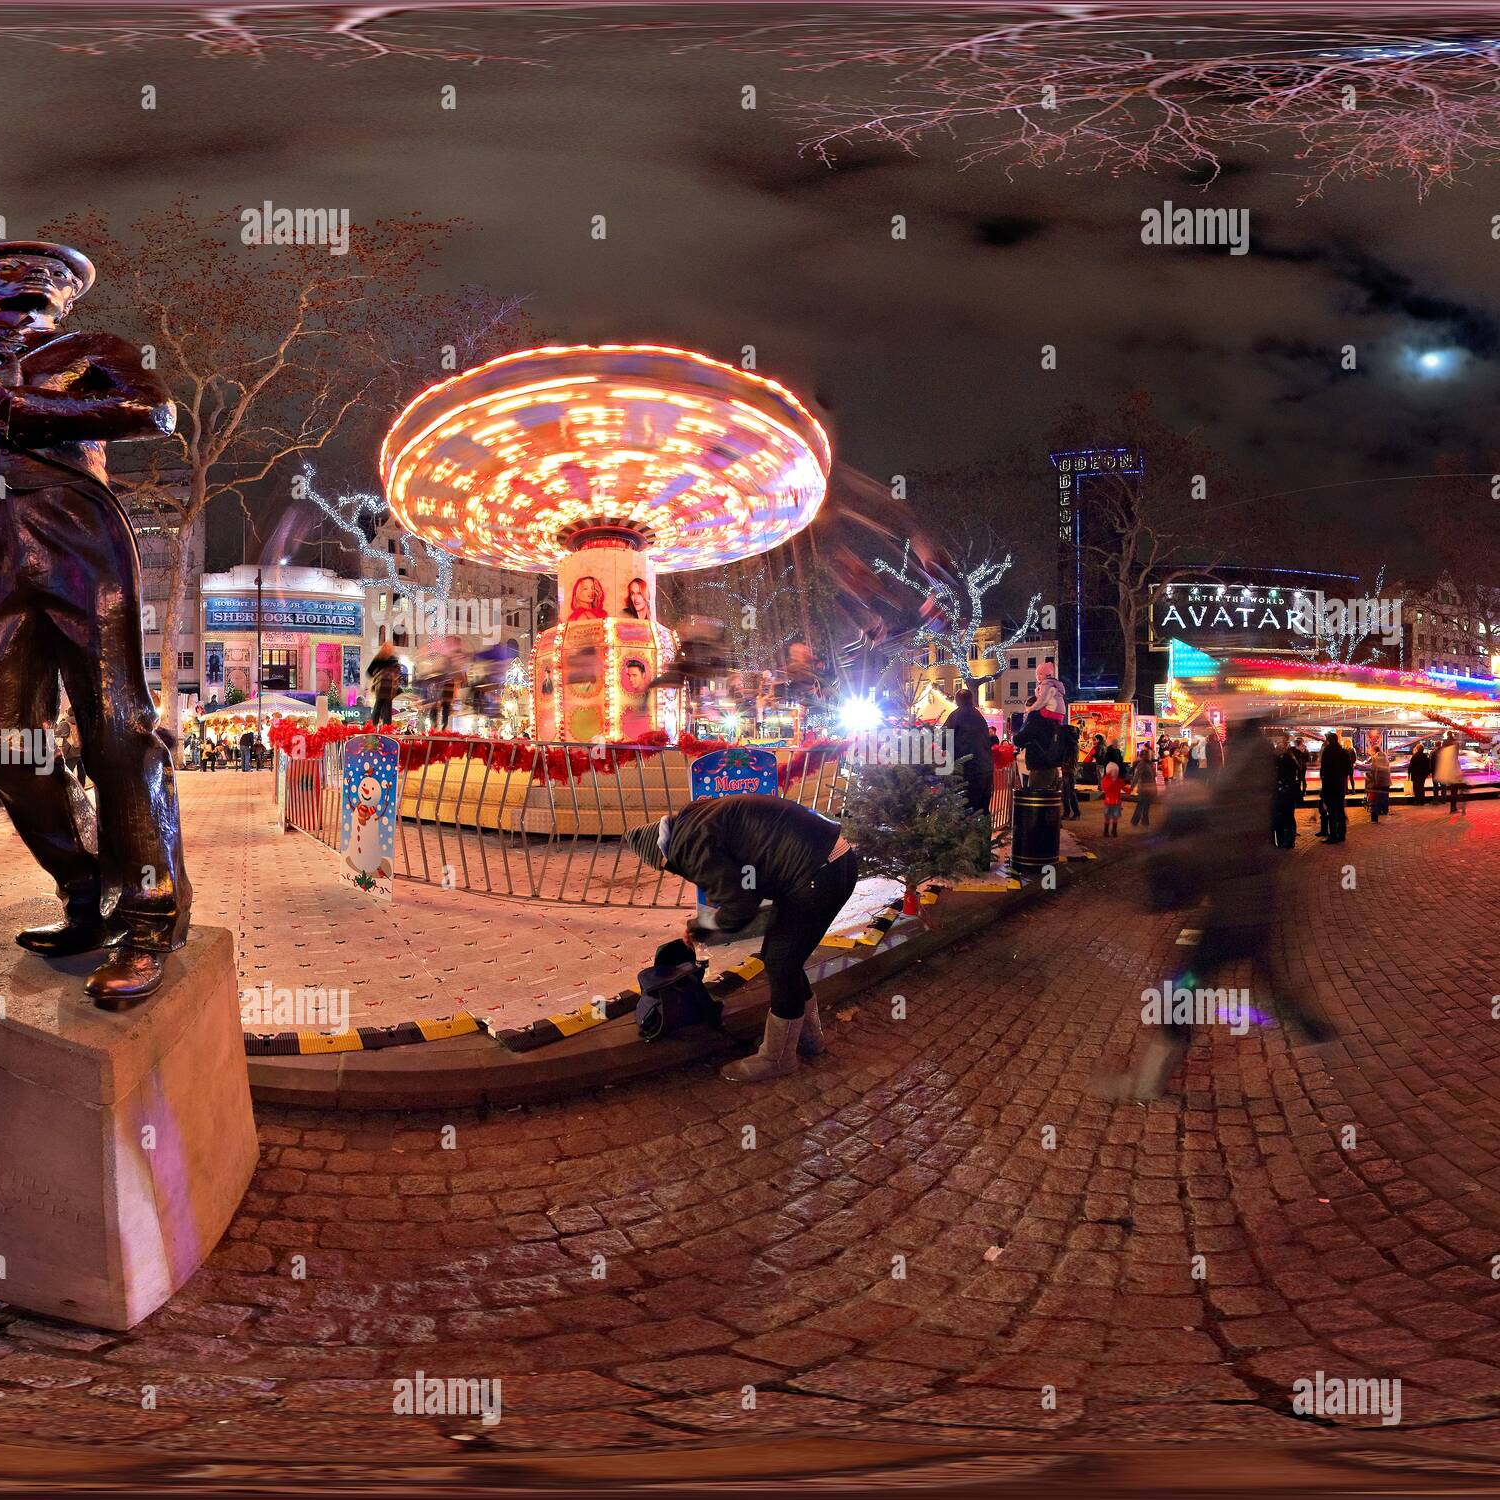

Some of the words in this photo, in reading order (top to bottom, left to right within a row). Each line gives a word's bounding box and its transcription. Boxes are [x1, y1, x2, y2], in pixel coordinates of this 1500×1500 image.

[1226, 595, 1244, 603] THE
[1250, 597, 1285, 605] WORLD
[214, 612, 294, 623] SHERLOCK
[295, 613, 355, 625] HOLMES
[1161, 605, 1309, 633] AVATAR
[714, 776, 760, 793] Merry
